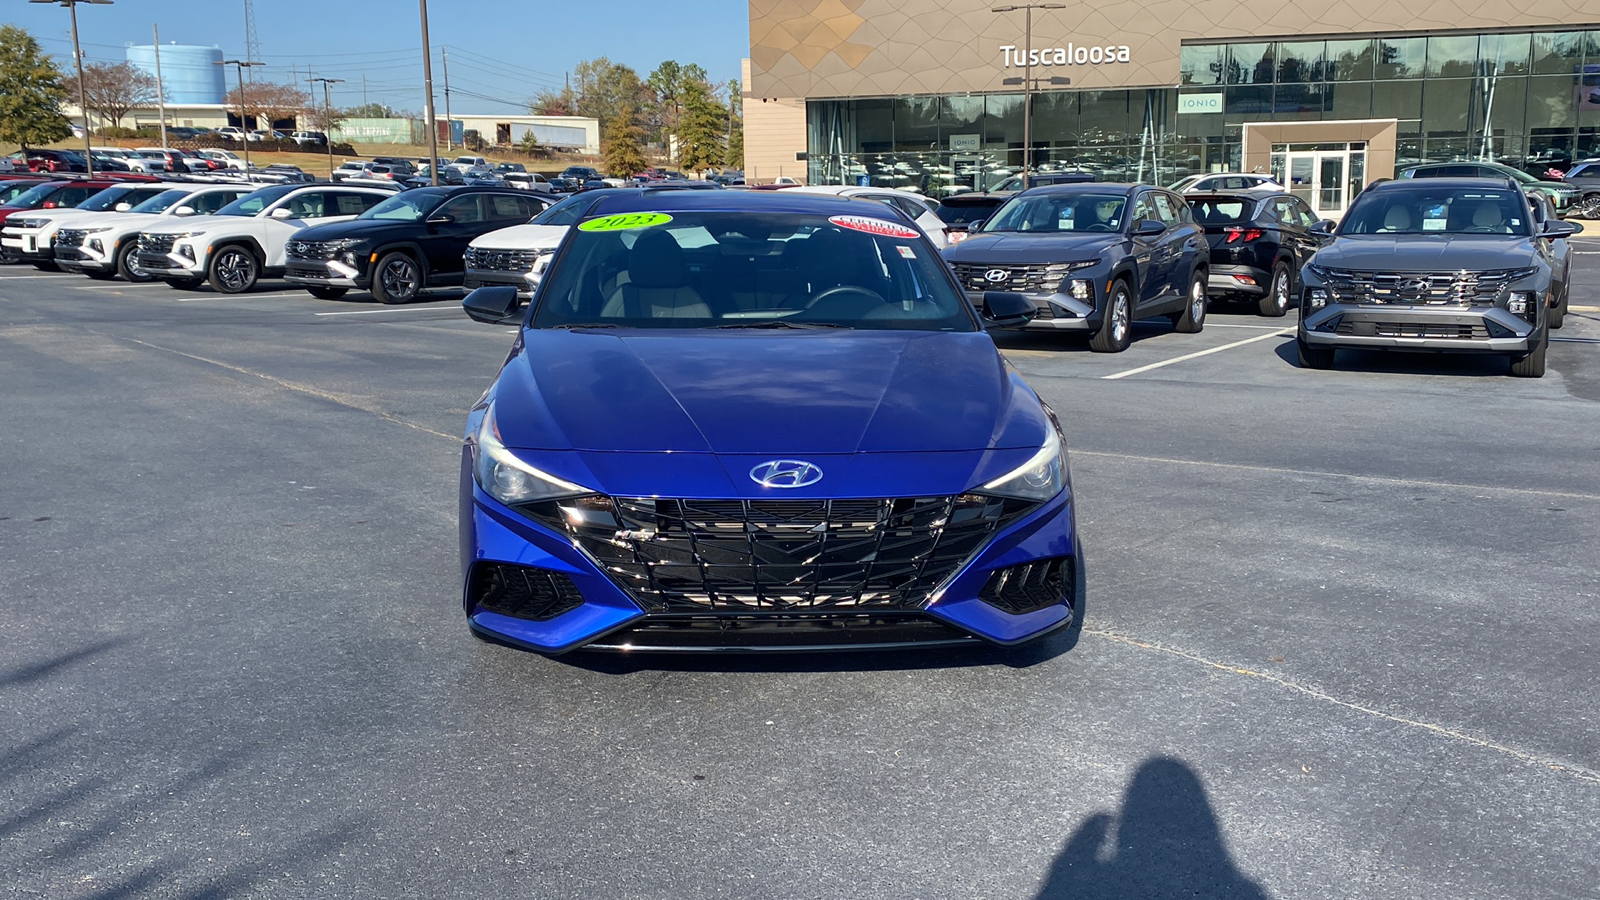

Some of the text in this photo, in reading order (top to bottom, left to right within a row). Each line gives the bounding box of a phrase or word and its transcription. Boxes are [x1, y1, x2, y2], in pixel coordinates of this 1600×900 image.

[999, 42, 1131, 68] Tuscaloosa
[1183, 99, 1217, 107] IONIQ
[593, 213, 658, 229] 2023
